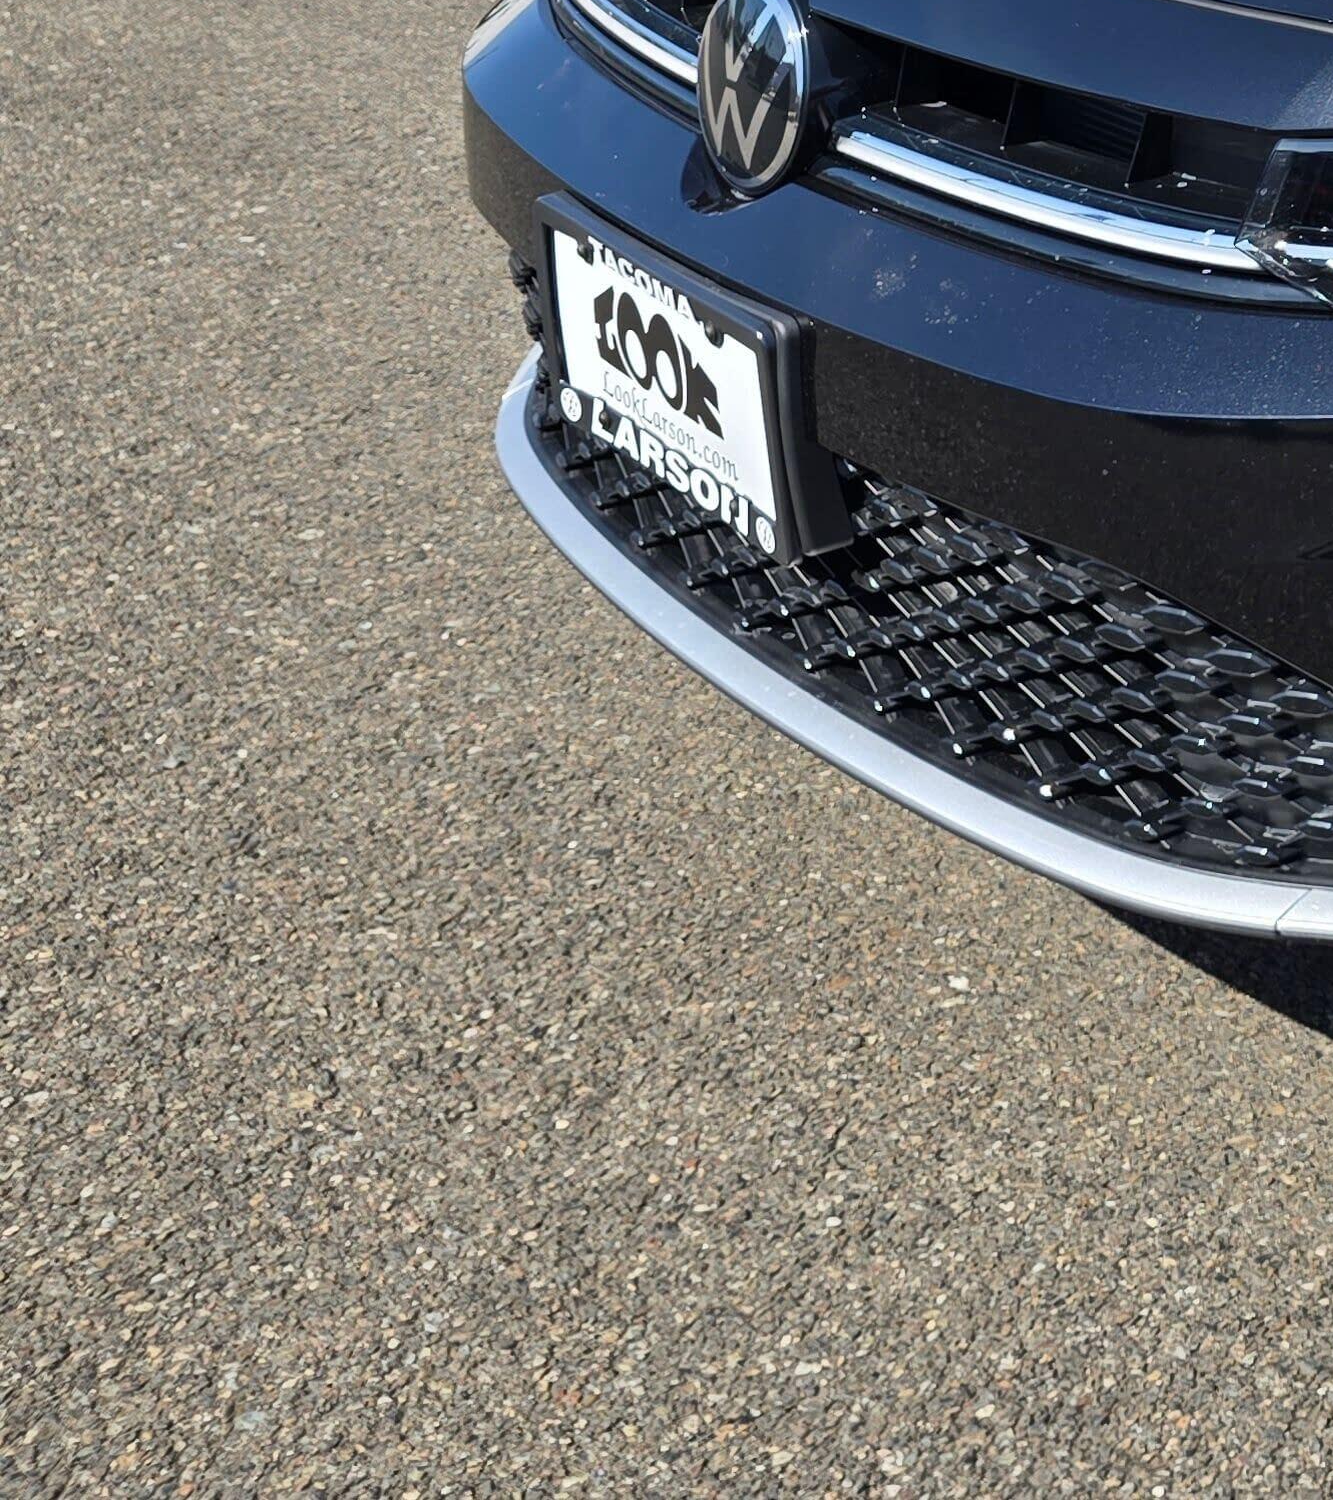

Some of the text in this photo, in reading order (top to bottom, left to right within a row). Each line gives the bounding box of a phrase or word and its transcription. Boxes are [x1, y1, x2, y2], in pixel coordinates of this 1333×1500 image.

[587, 235, 700, 326] TACOMA
[591, 397, 749, 538] LARSON
[603, 371, 738, 481] LookLarson.com
